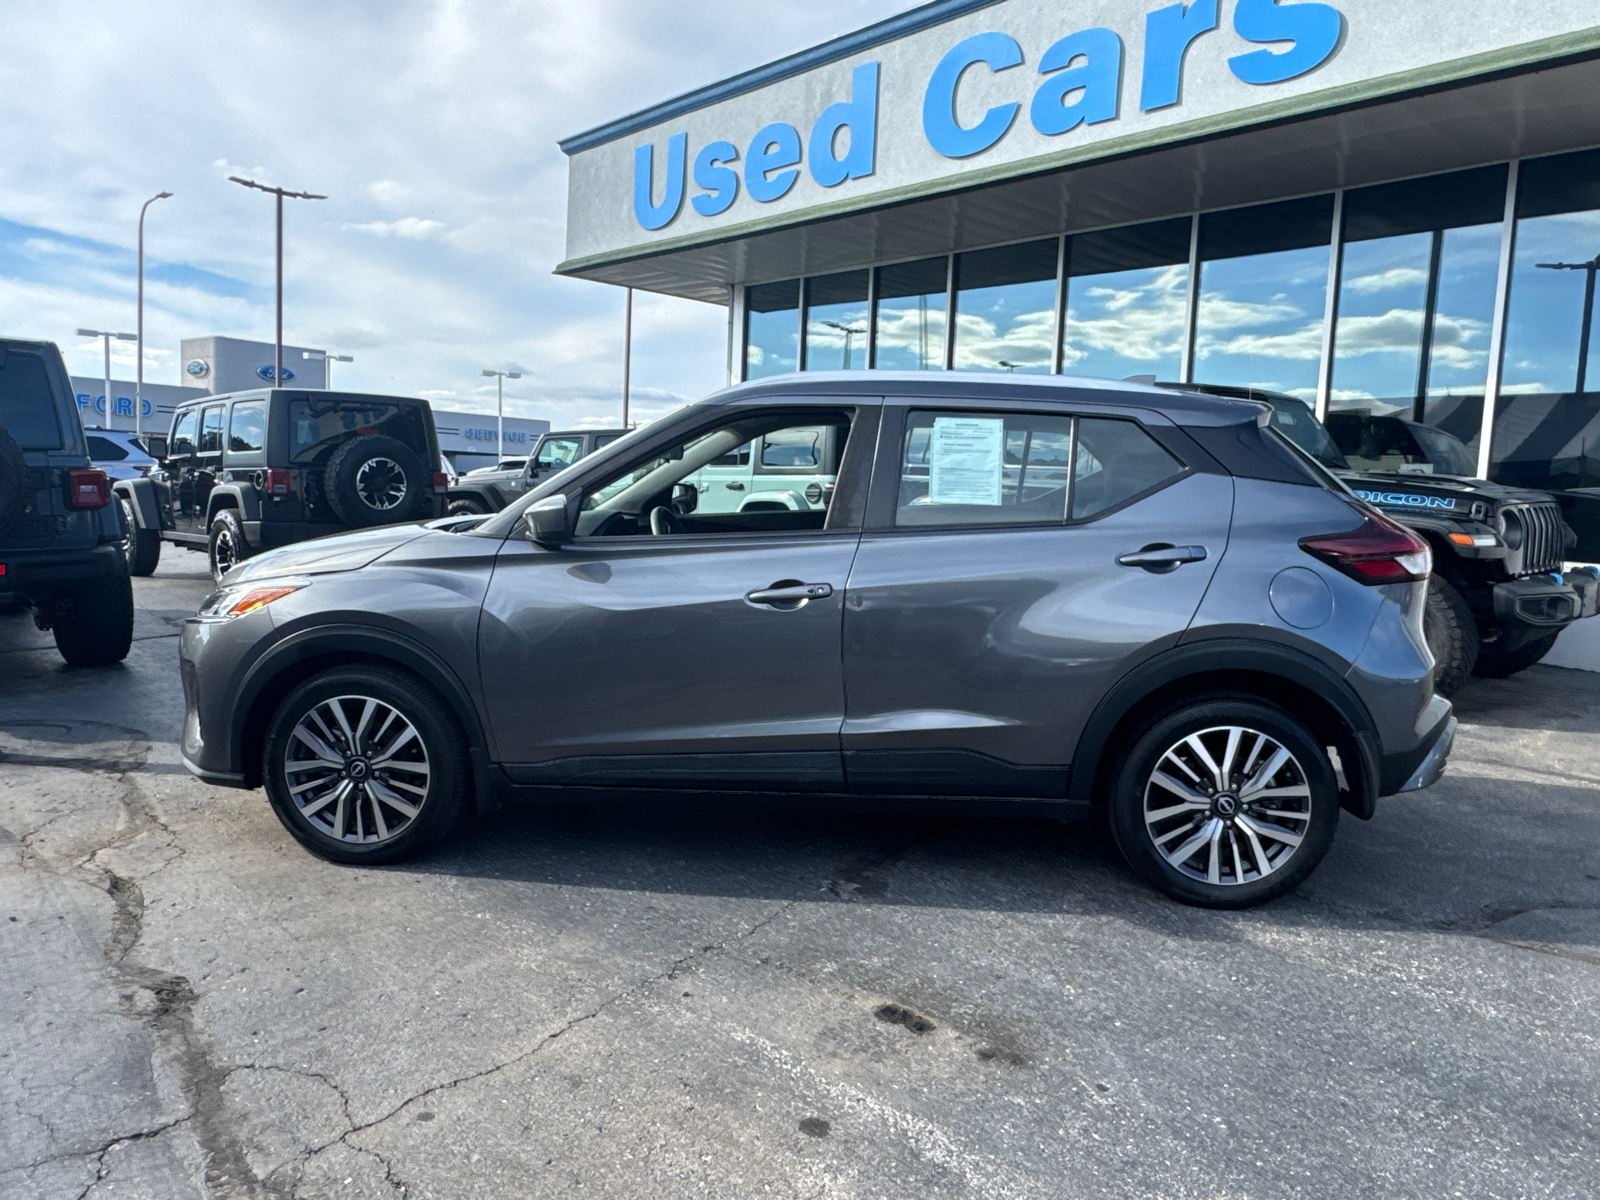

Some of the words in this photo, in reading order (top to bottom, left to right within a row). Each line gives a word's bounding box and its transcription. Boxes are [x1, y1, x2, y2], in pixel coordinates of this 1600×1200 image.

[633, 60, 880, 231] Used
[922, 0, 1344, 158] Cars
[76, 393, 153, 417] FORD
[465, 427, 527, 443] SERICE
